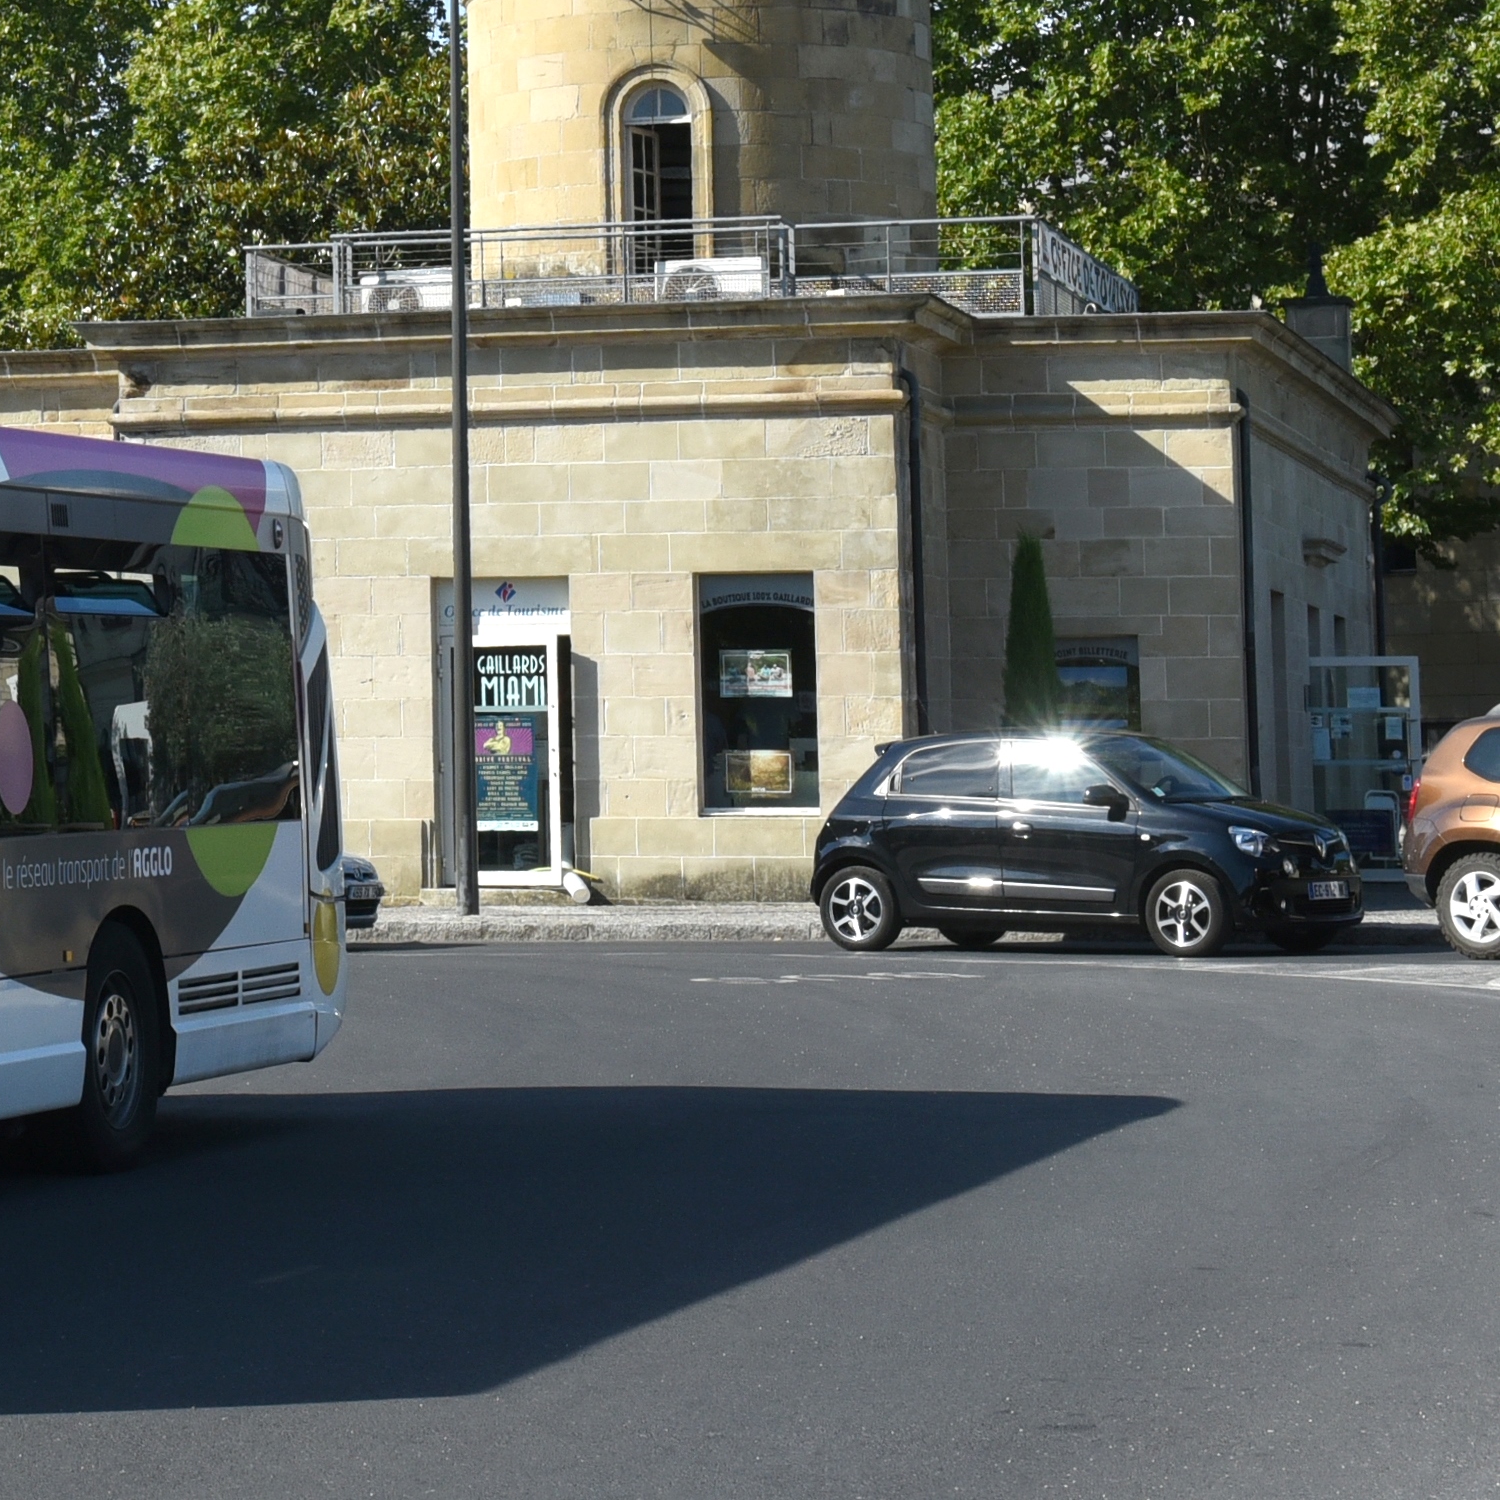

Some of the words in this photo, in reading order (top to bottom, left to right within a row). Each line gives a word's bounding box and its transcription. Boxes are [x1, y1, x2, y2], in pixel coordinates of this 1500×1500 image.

[702, 600, 712, 609] LA
[712, 592, 751, 606] BOUTIQUE
[752, 591, 772, 601] 100%
[488, 604, 501, 617] de
[504, 603, 567, 617] Tourisme
[1078, 646, 1128, 660] BILLETTERIE
[477, 654, 545, 674] GAILLARDS
[481, 675, 545, 706] MIAMI
[3, 858, 13, 890] le
[16, 855, 55, 889] réseau
[58, 853, 109, 890] transport
[112, 851, 125, 881] de
